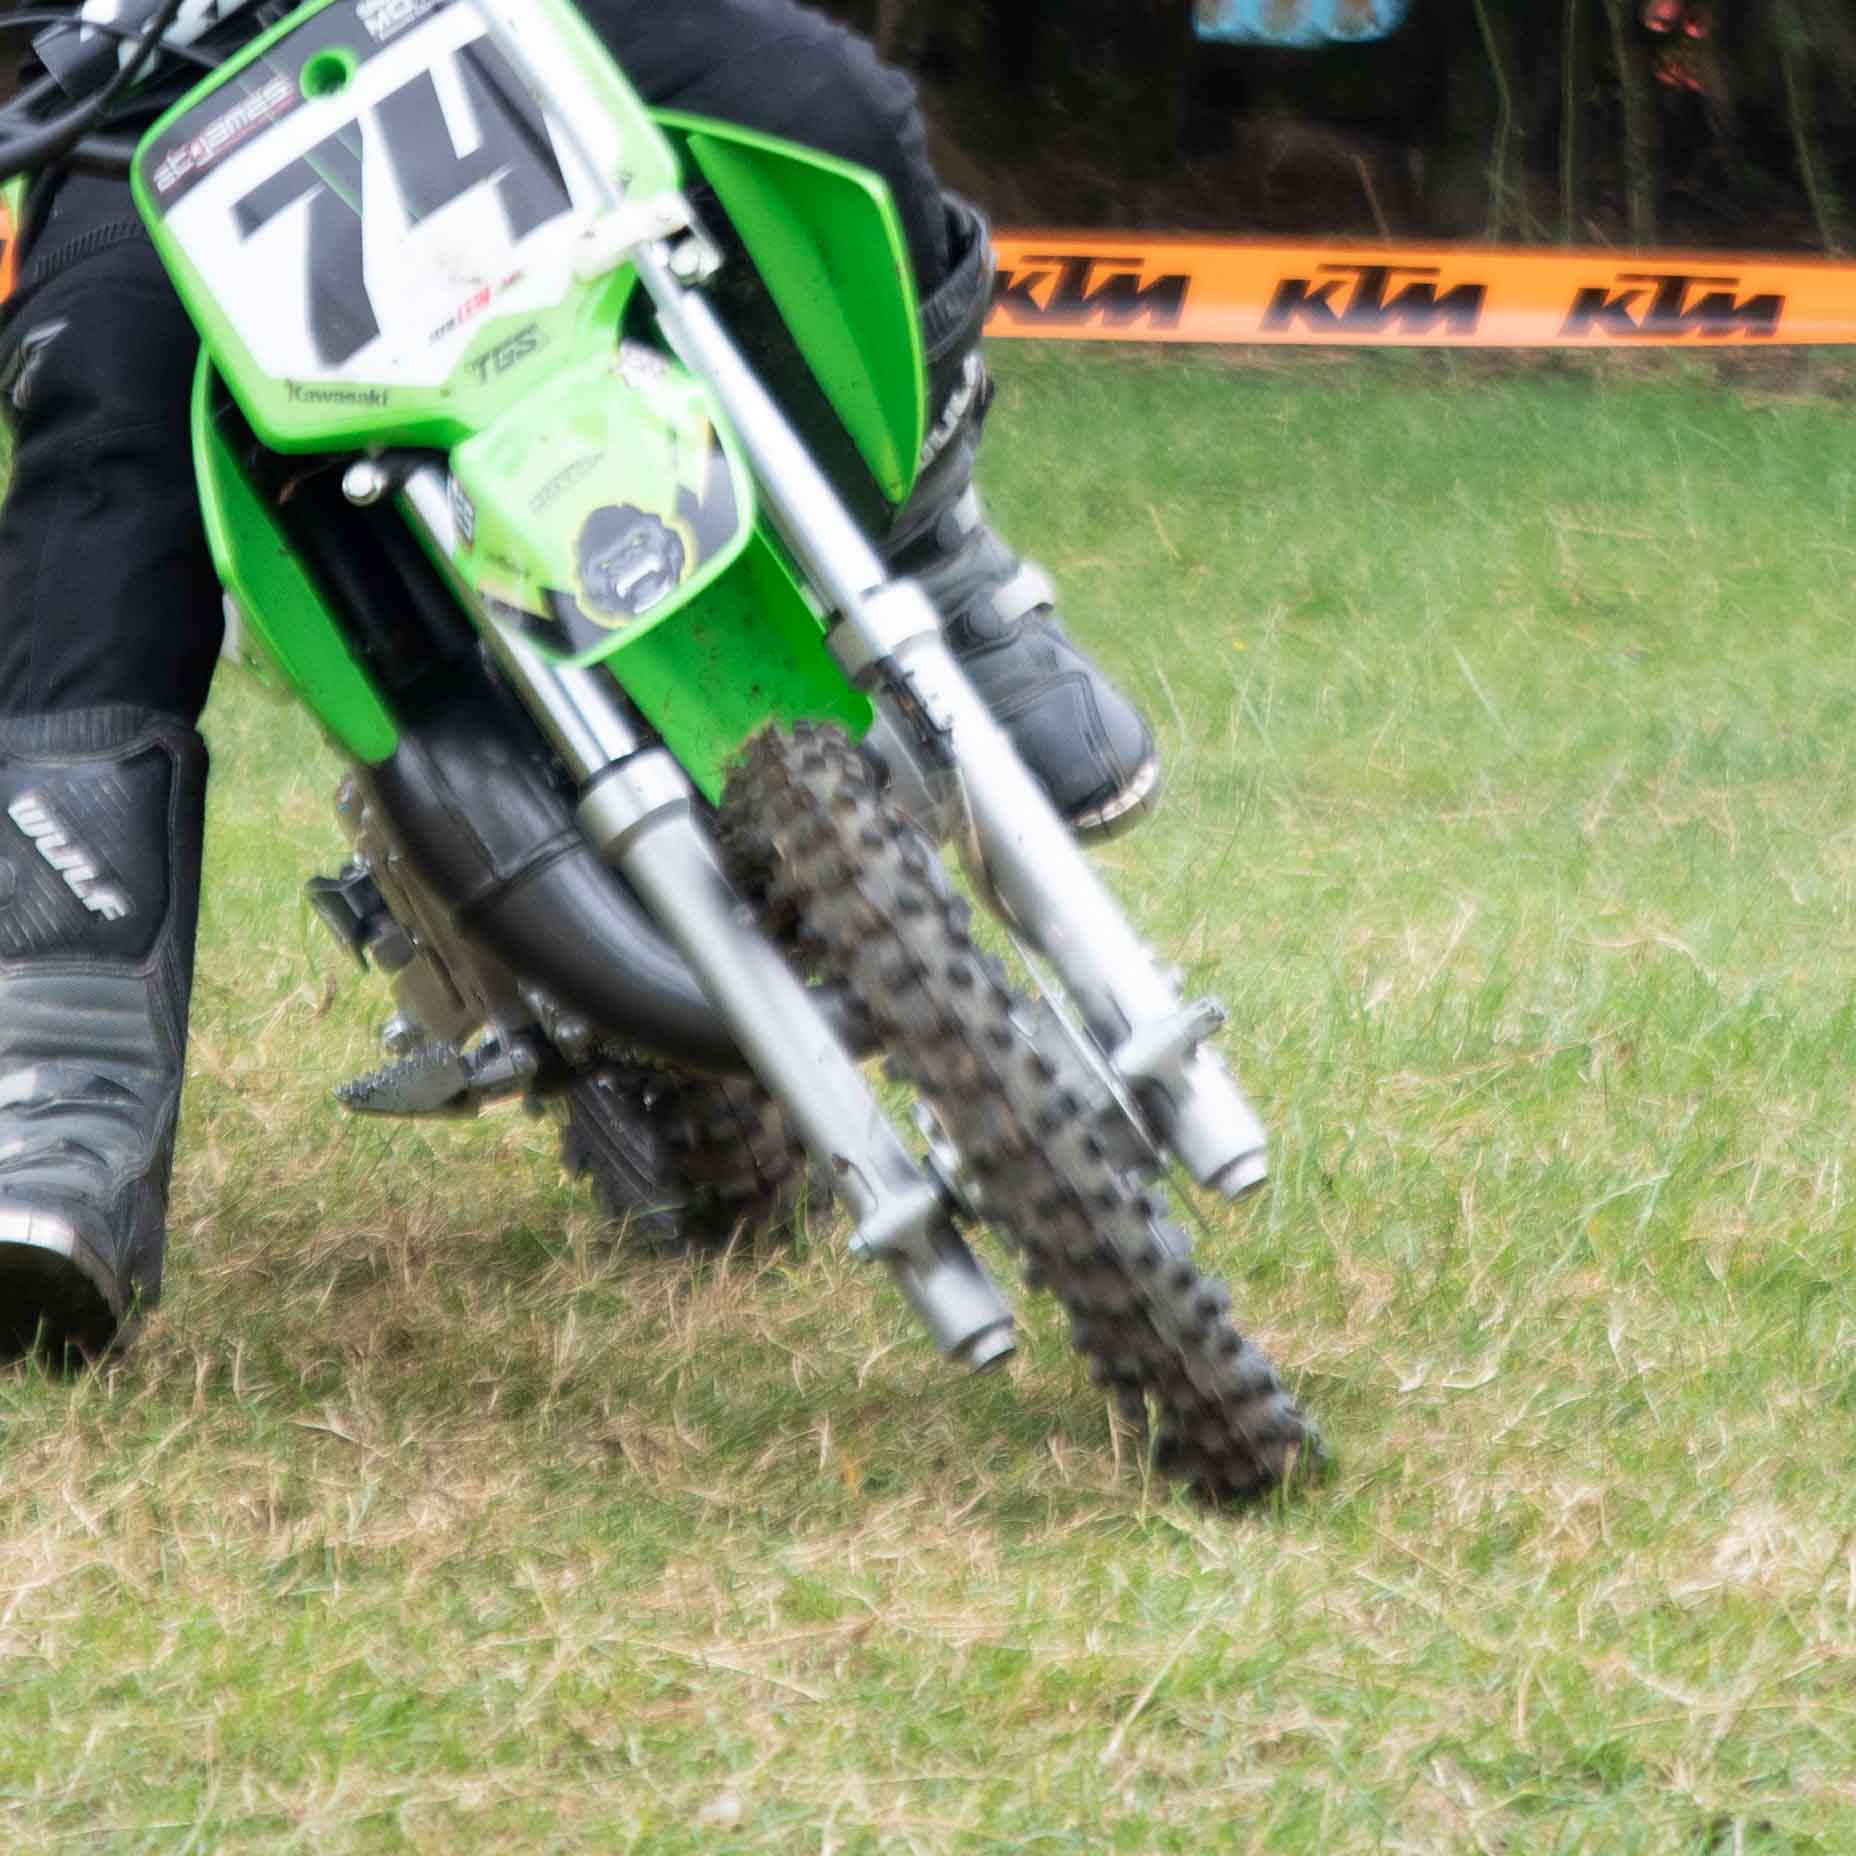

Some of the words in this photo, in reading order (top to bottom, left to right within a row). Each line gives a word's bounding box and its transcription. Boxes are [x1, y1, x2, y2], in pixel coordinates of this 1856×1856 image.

[229, 33, 574, 371] 74
[1259, 263, 1489, 335] KTM
[1556, 273, 1786, 338] KTM
